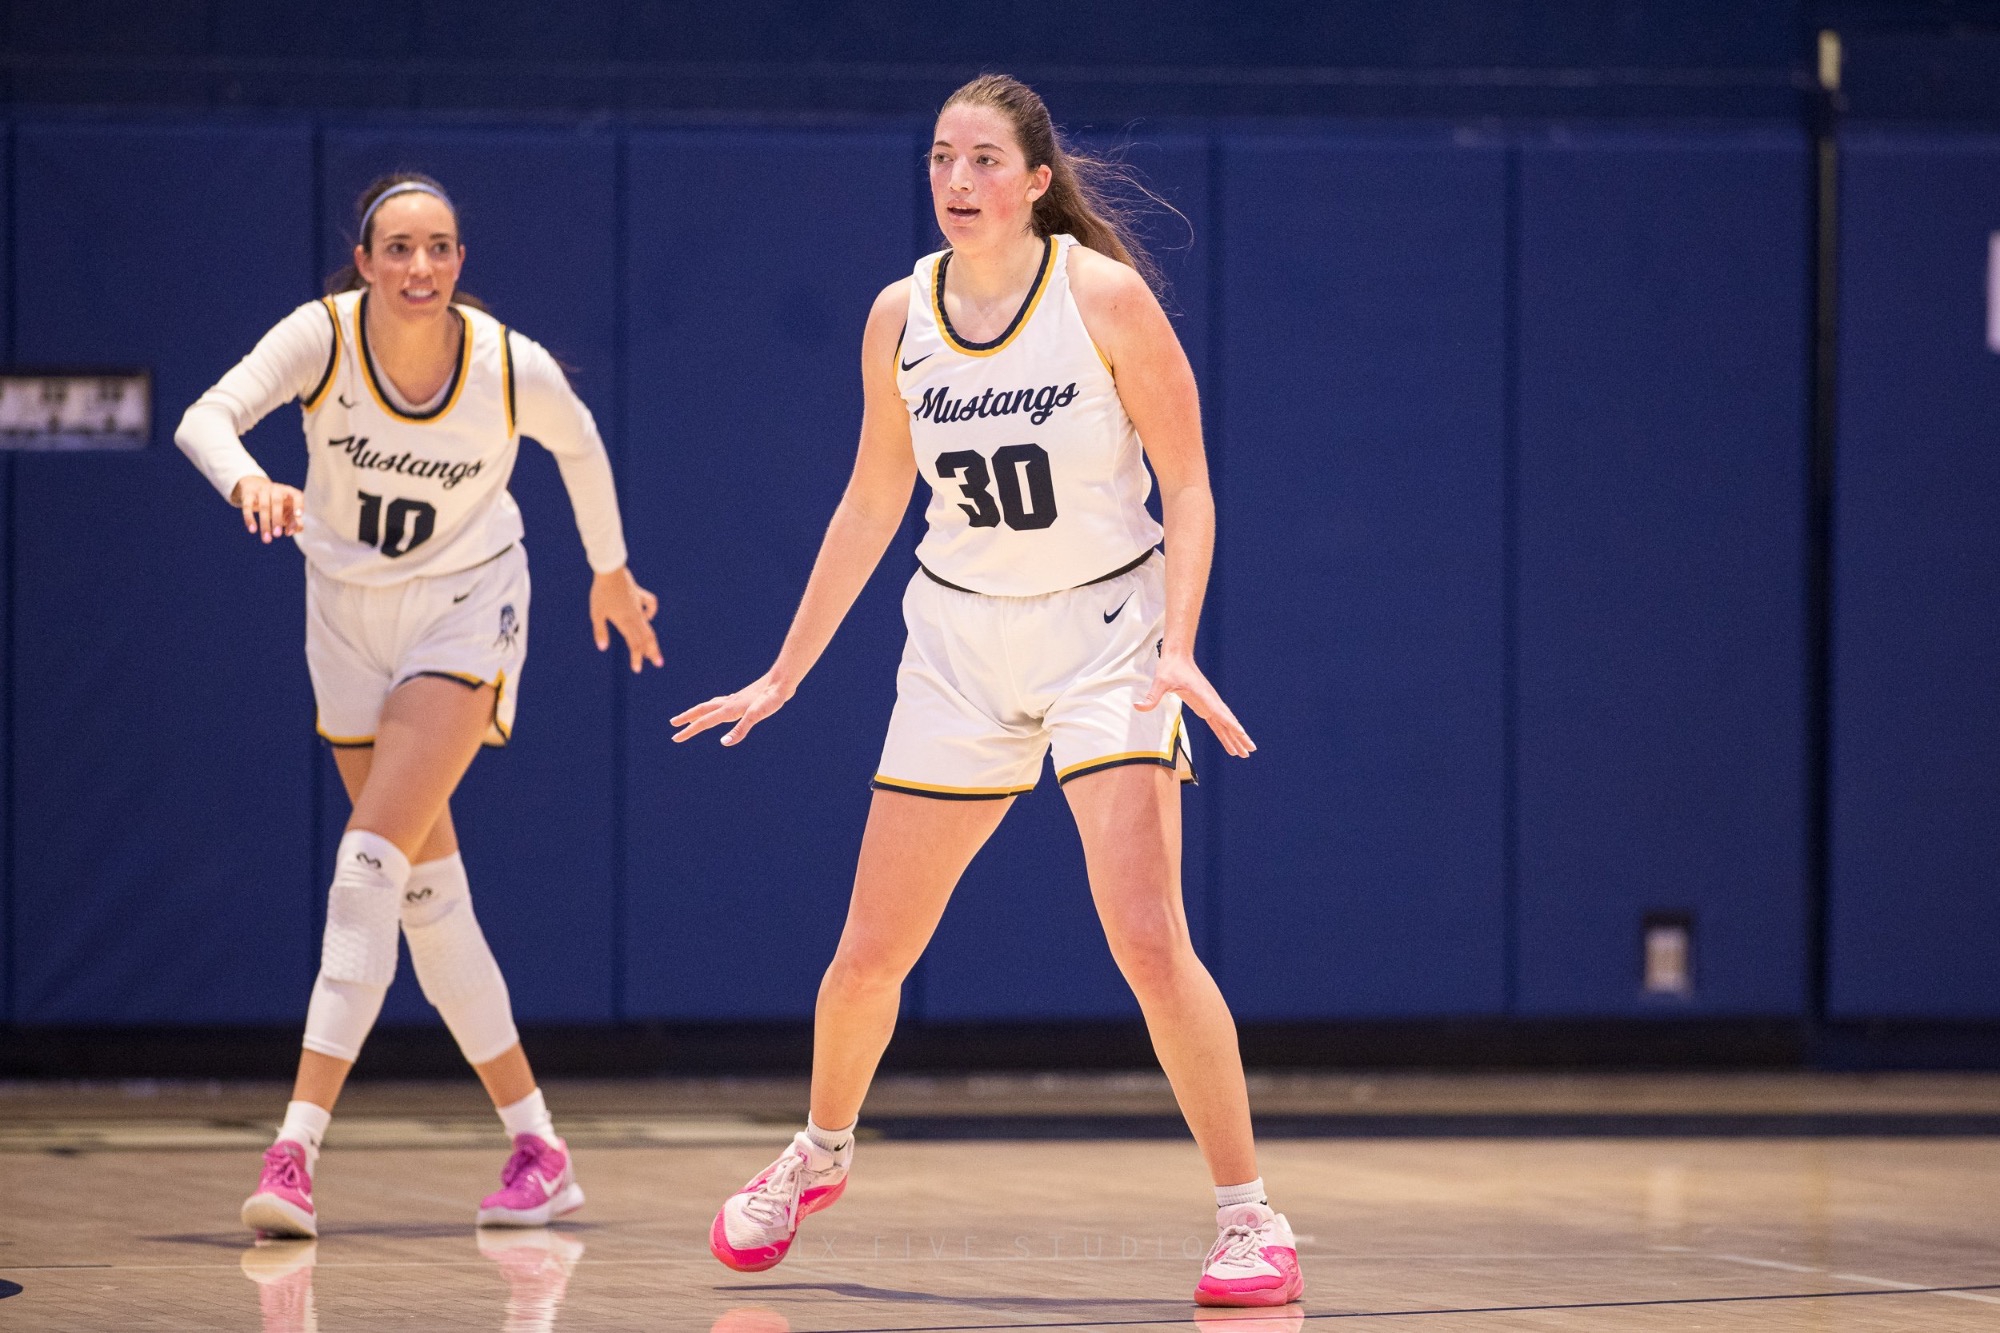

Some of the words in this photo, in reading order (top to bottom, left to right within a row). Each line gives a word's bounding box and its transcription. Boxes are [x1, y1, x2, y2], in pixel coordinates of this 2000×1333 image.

[912, 382, 1080, 426] Mustangs
[328, 435, 485, 490] Mustangs
[934, 442, 1058, 531] 30
[357, 490, 437, 558] 10
